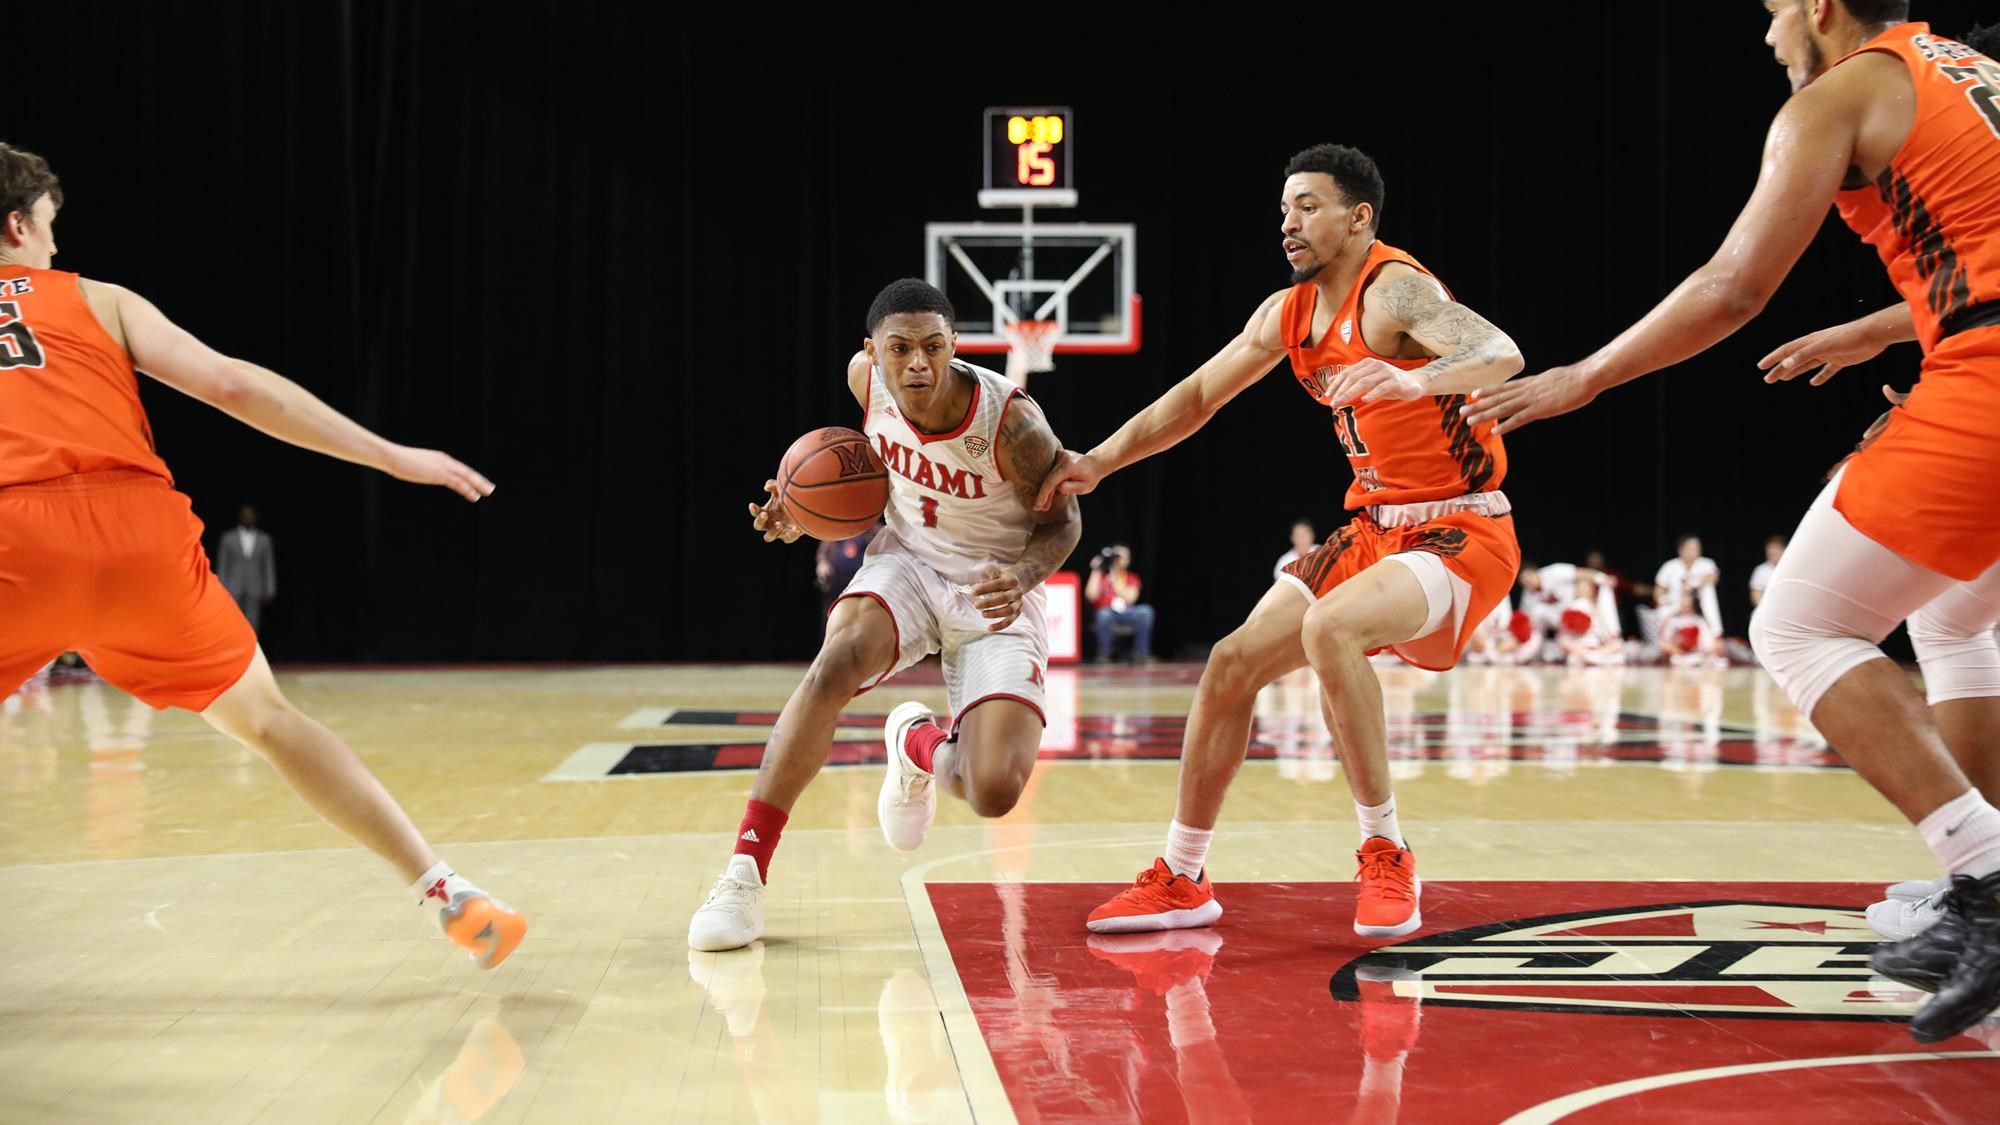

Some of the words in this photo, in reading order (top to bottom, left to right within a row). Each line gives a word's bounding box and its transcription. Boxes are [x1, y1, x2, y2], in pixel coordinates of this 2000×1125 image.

[1018, 142, 1055, 186] 15
[830, 443, 877, 478] M
[877, 433, 987, 499] MIAMI
[919, 495, 939, 528] 1
